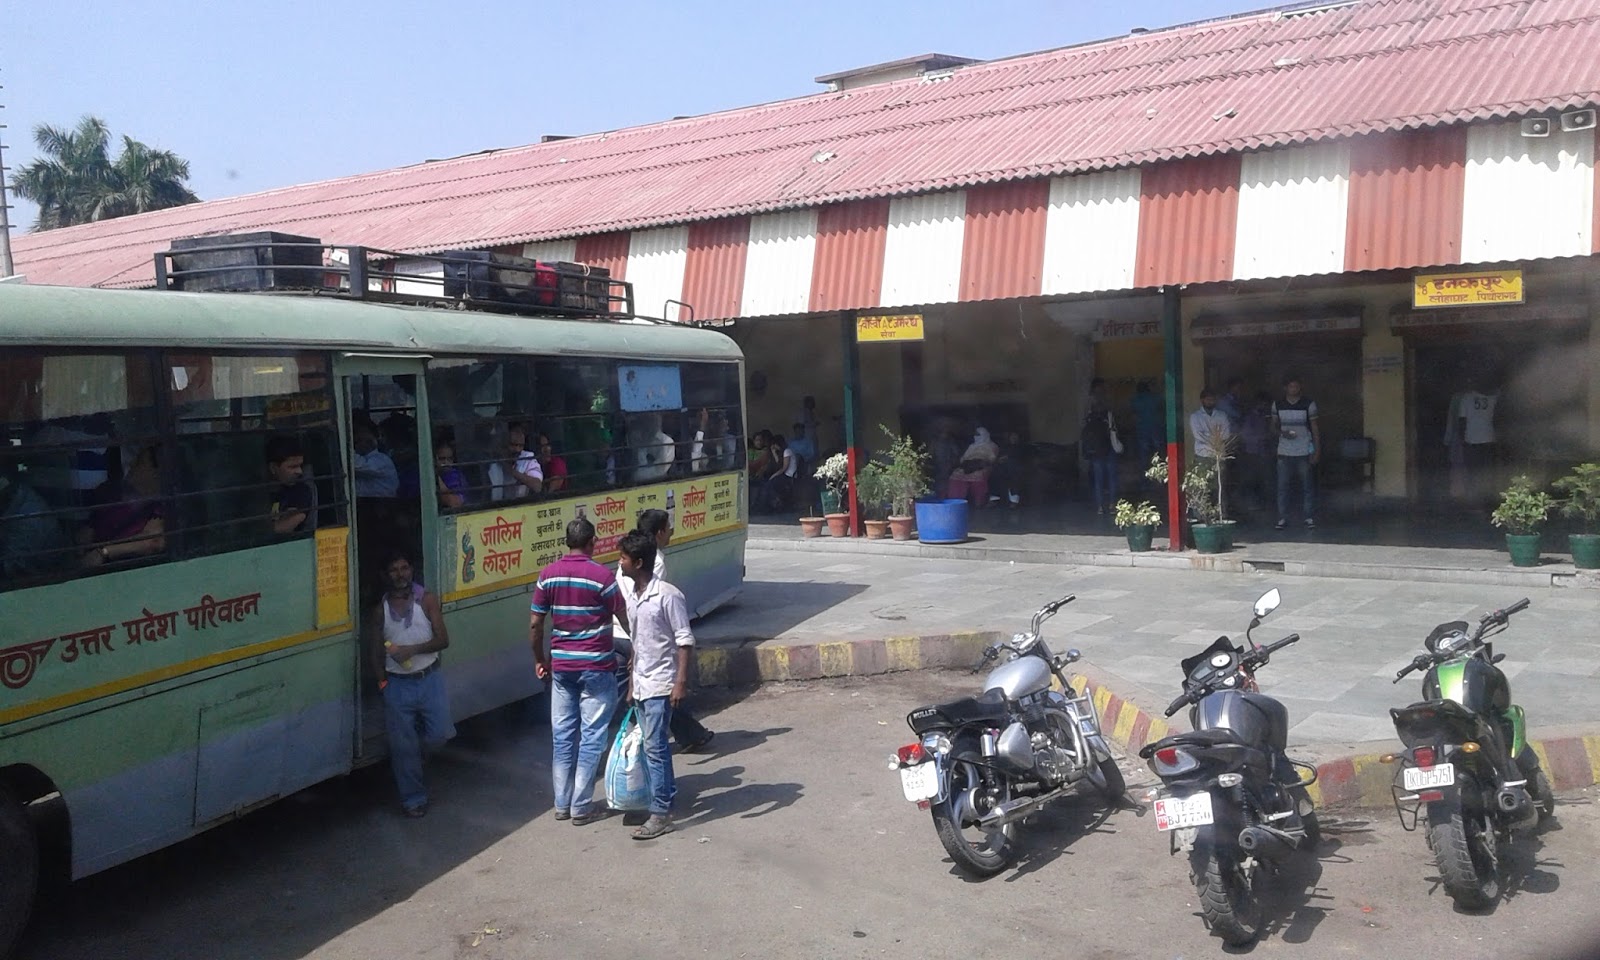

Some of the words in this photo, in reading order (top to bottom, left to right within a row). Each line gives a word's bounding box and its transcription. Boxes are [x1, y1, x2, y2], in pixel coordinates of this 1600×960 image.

[593, 496, 626, 516] जालिम
[682, 485, 706, 508] जालिम
[556, 519, 563, 530] की
[596, 518, 626, 535] लोशन
[682, 510, 707, 530] लोशन
[480, 515, 523, 546] जालिम
[530, 539, 556, 552] असरदार
[482, 548, 523, 575] लोशन
[60, 624, 116, 663] उत्तर
[121, 607, 179, 646] प्रदेश
[183, 592, 261, 631] परिवहन
